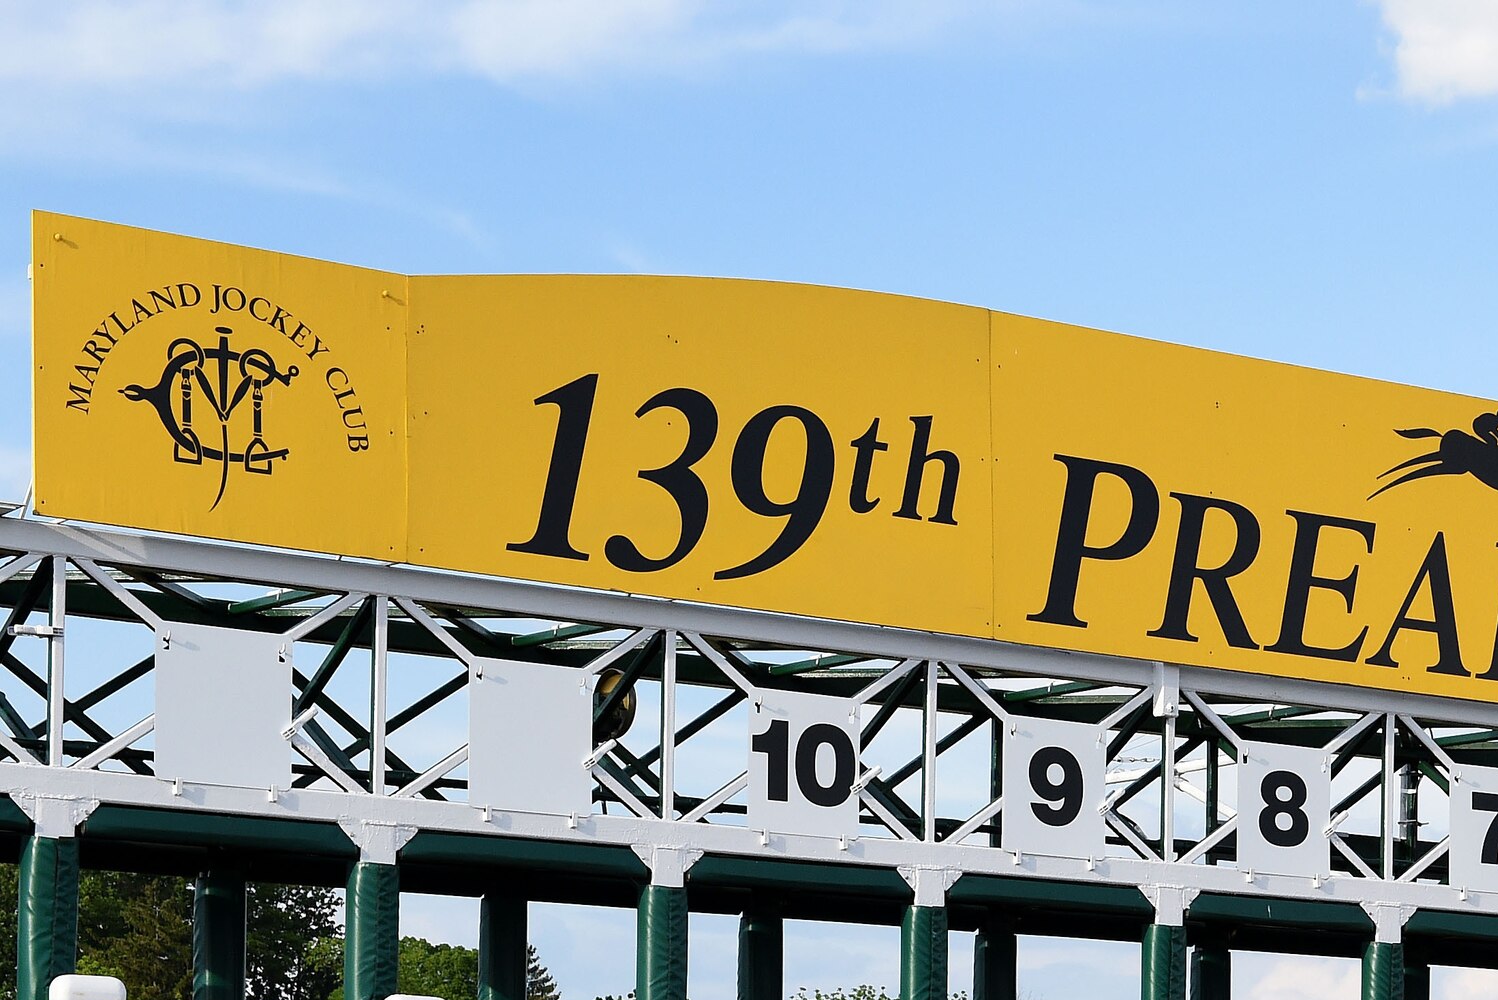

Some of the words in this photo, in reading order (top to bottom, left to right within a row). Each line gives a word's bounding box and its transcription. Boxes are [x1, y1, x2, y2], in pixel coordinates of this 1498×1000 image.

[66, 283, 201, 415] MARYLAND
[210, 284, 330, 361] JOCKEY
[325, 367, 370, 454] CLUB
[505, 373, 960, 581] 139th
[751, 719, 856, 808] 10
[1028, 746, 1084, 827] 9
[1258, 770, 1309, 848] 8
